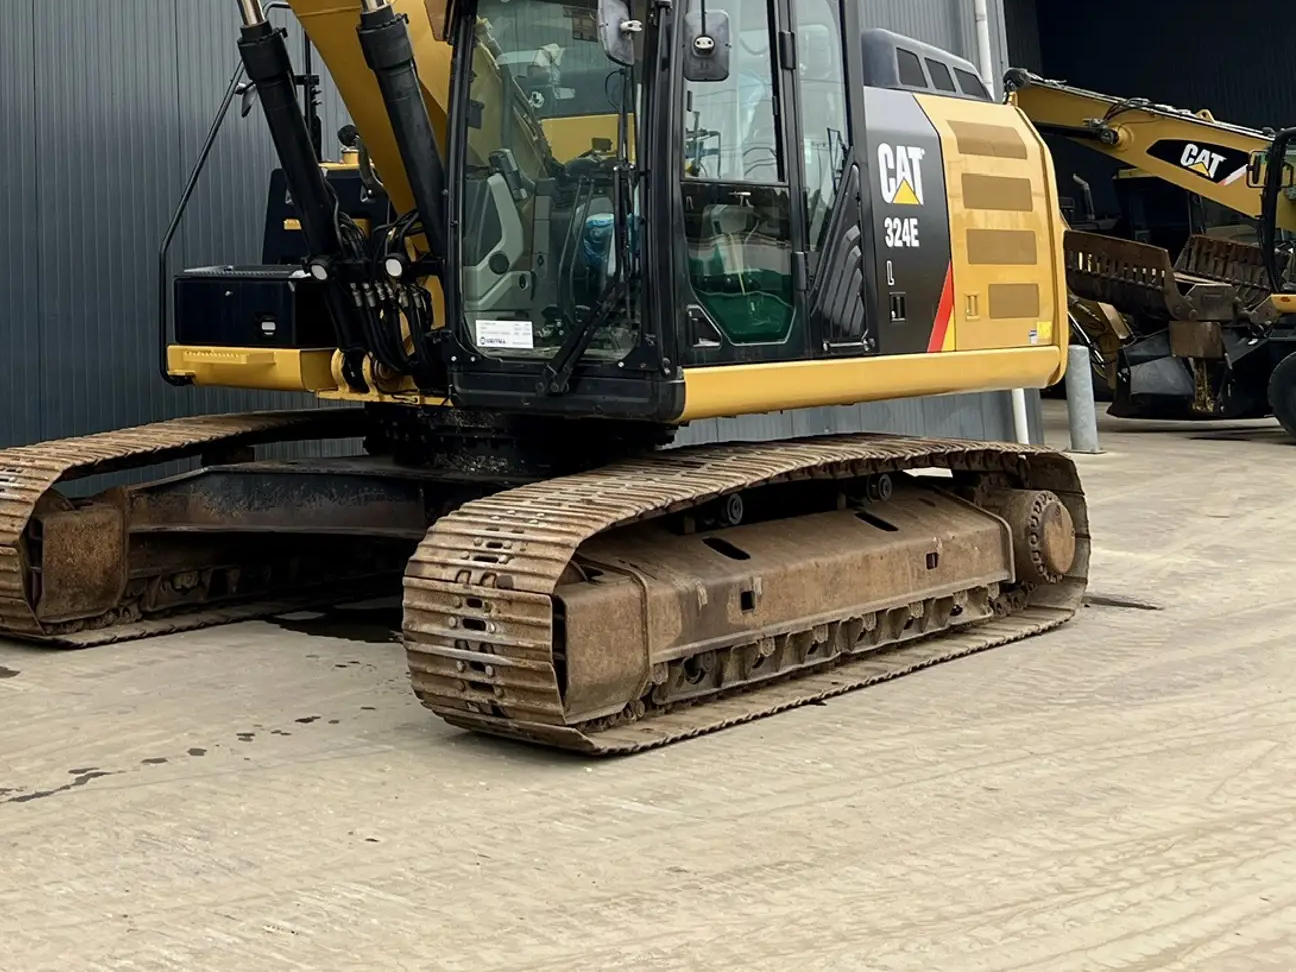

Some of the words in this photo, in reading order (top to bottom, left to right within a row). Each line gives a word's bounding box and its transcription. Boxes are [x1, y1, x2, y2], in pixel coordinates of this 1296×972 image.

[877, 142, 925, 206] CAT
[1180, 143, 1227, 179] CAT
[884, 217, 920, 247] 324E
